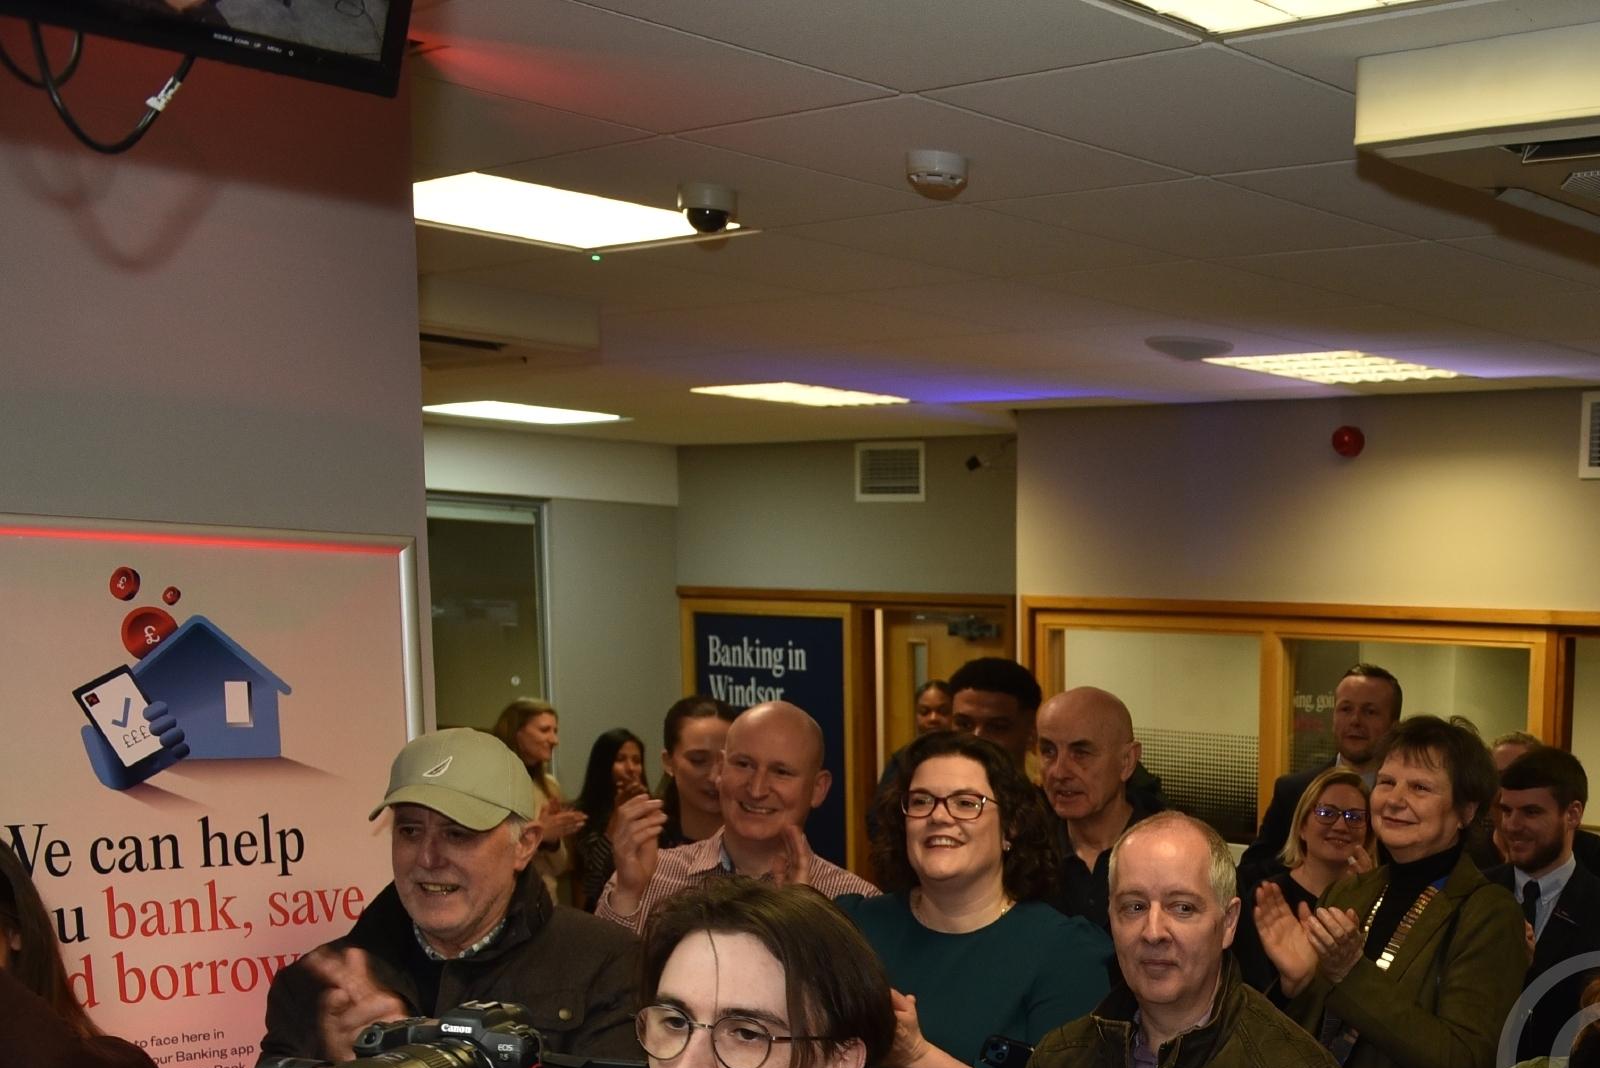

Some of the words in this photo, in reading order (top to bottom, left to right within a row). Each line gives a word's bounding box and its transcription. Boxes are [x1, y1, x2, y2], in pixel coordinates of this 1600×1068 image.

[708, 634, 784, 678] Banking
[788, 640, 807, 671] in
[709, 674, 785, 707] Windsor
[4, 823, 72, 877] We
[89, 829, 184, 874] can
[198, 813, 305, 876] help
[103, 880, 254, 939] bank,
[268, 884, 365, 927] save
[151, 1035, 179, 1047] face
[181, 1032, 211, 1043] here
[213, 1028, 225, 1040] in
[441, 1023, 473, 1034] Canon
[152, 1054, 173, 1065] our
[175, 1047, 228, 1063] Banking
[230, 1044, 255, 1058] app
[497, 1043, 513, 1052] EOS
